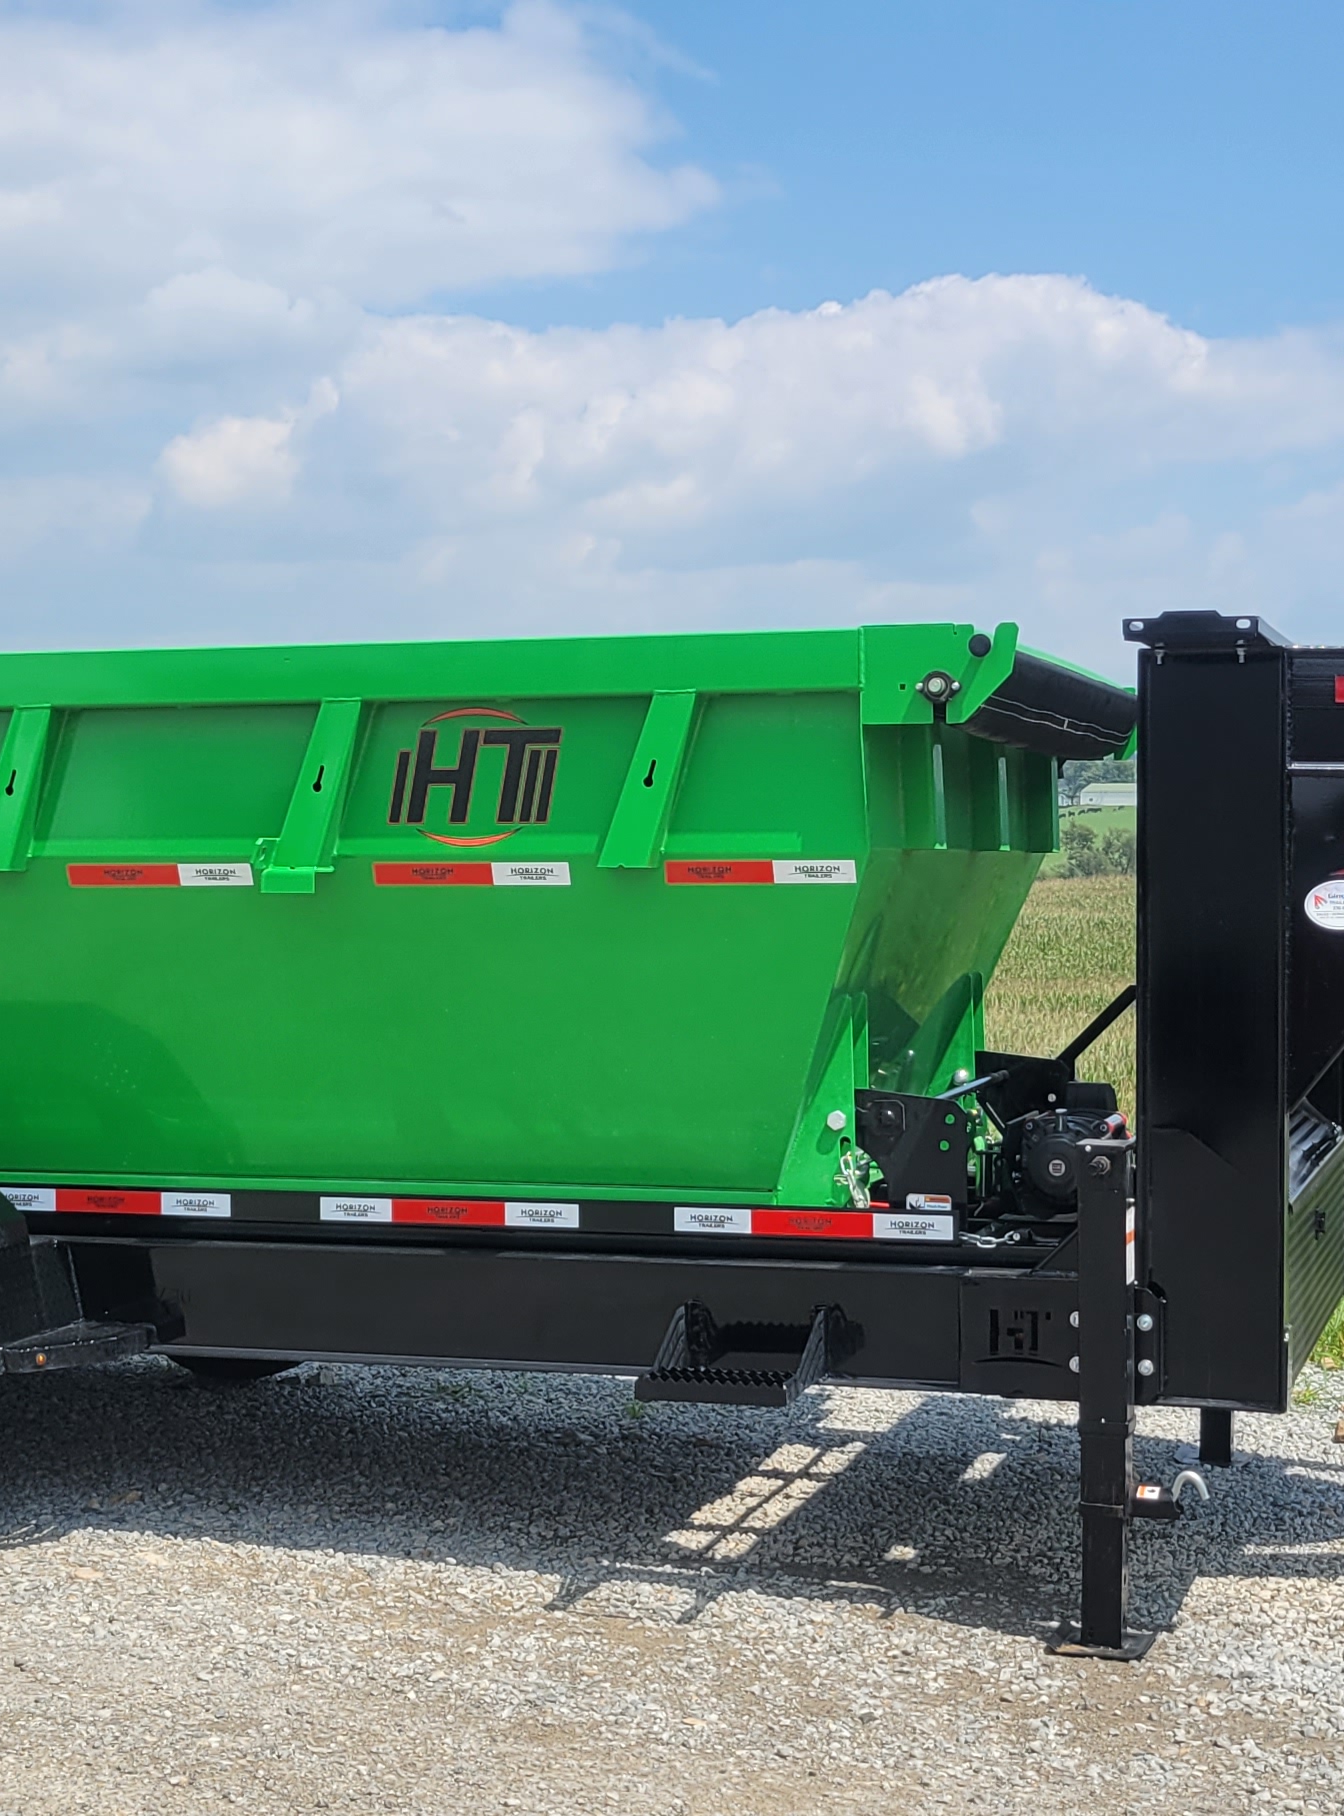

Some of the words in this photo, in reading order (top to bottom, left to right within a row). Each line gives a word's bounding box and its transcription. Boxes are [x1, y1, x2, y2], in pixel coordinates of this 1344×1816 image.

[510, 867, 554, 875] HORIZON
[794, 865, 841, 873] HORIZON
[6, 1193, 40, 1201] ORIZON
[175, 1198, 215, 1207] HORIZON
[335, 1203, 376, 1211] HORIZON
[520, 1208, 563, 1217] HORIZON
[689, 1213, 734, 1222] HORIZON
[889, 1219, 935, 1229] HORIZON
